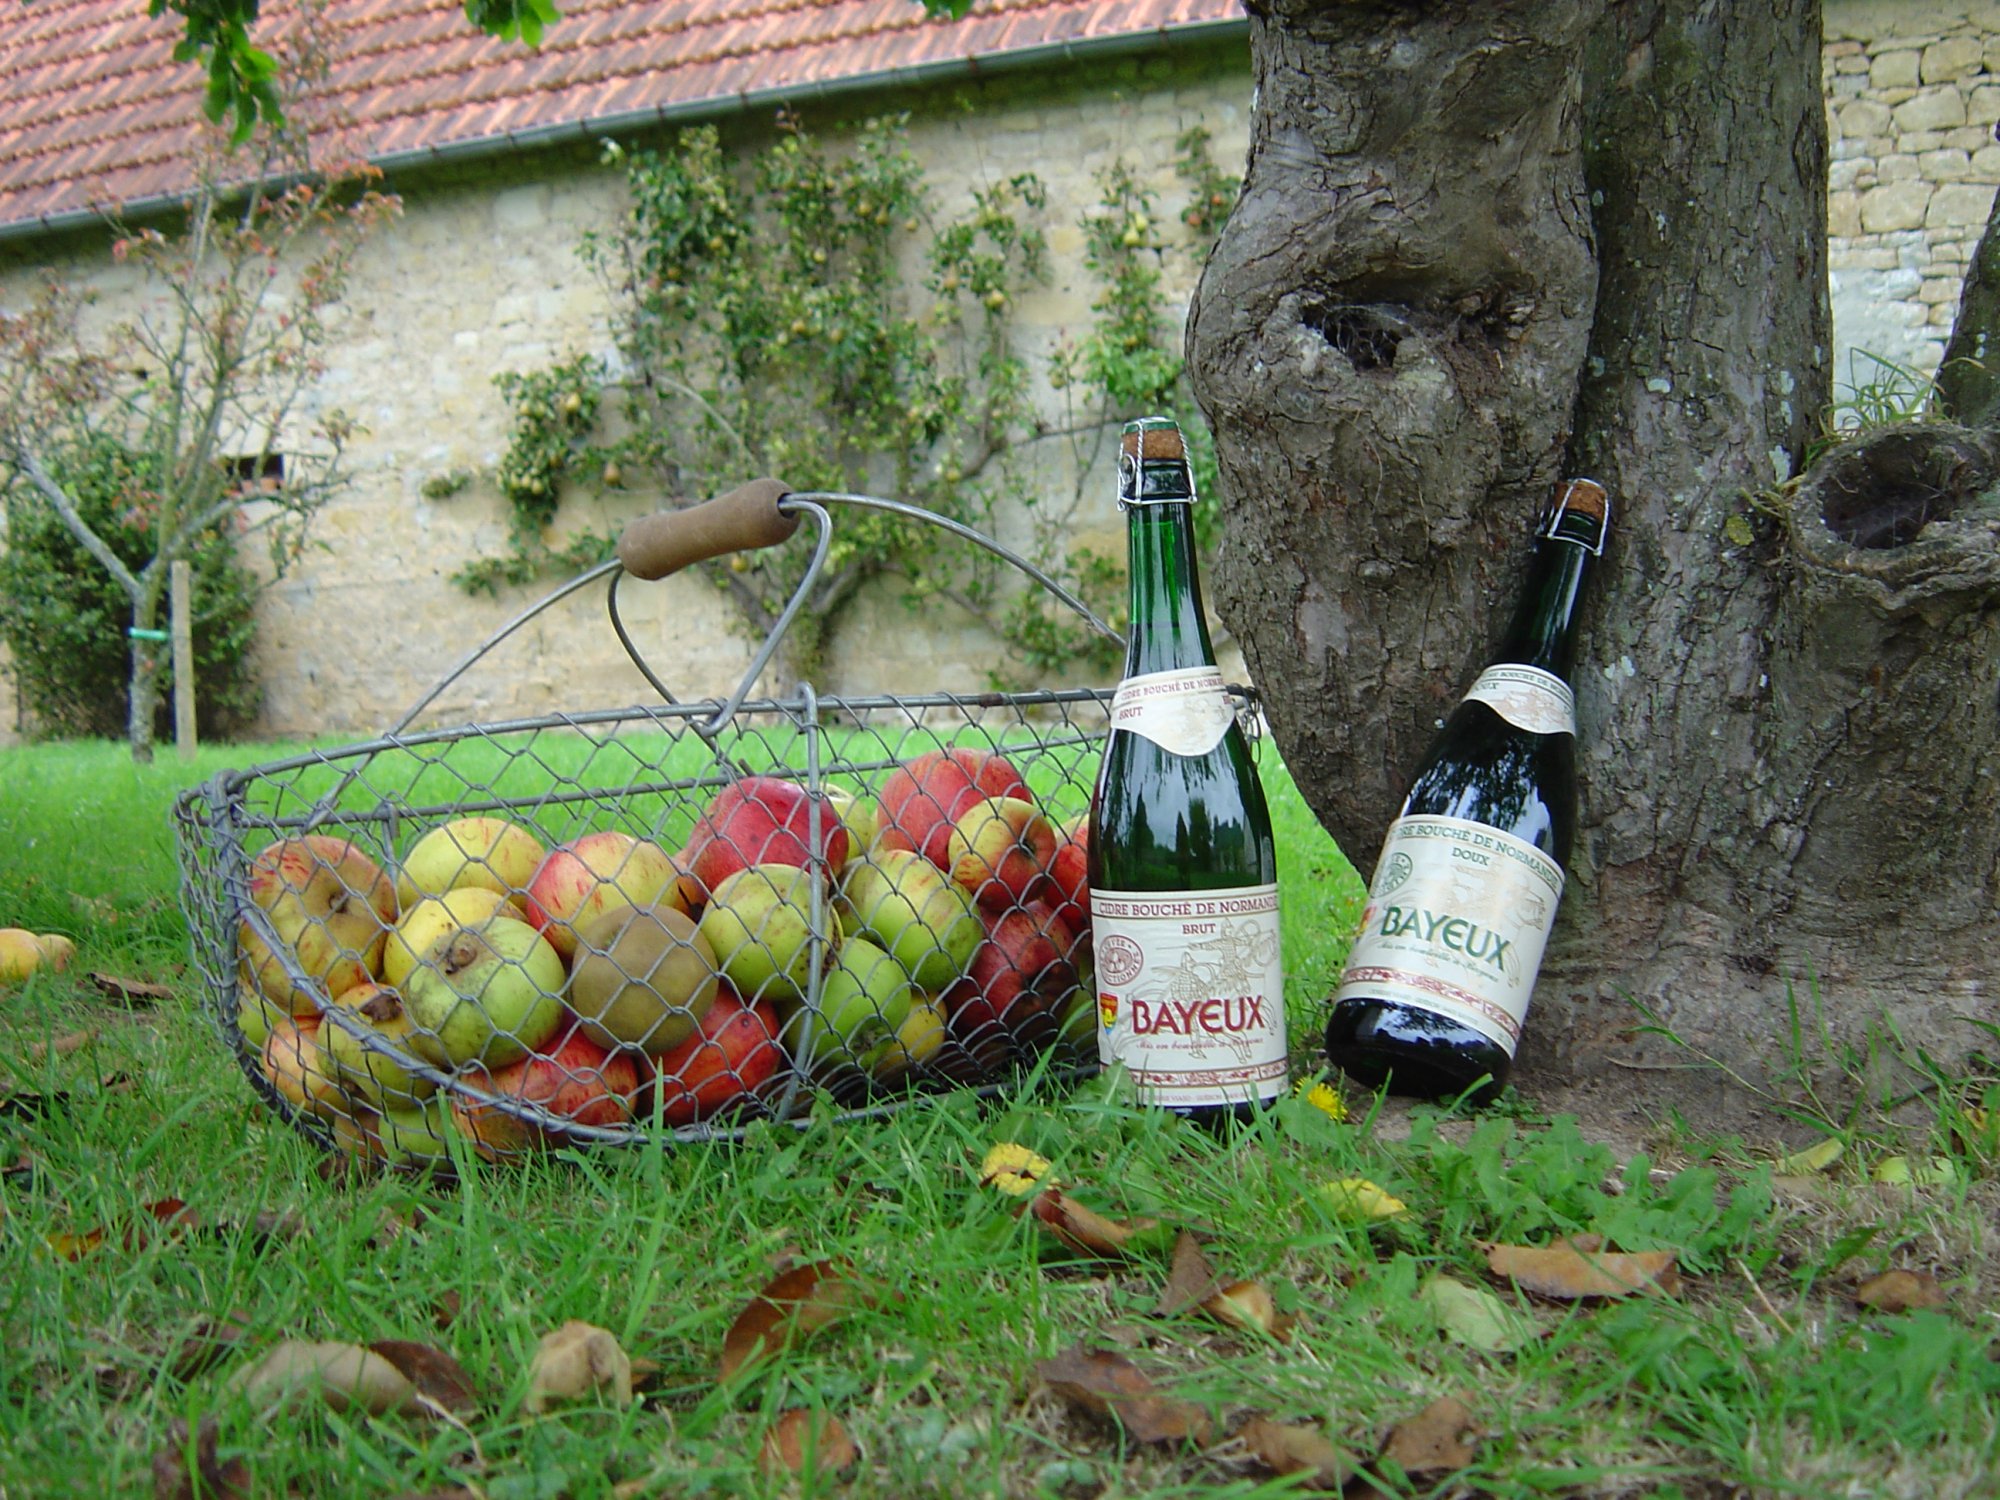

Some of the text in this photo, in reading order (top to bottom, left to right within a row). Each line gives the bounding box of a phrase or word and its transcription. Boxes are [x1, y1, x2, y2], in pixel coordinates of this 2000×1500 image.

[1120, 688, 1142, 701] CIDRE
[1143, 682, 1182, 696] BOUCHÉ
[1183, 680, 1196, 691] DE
[1118, 706, 1144, 721] BRUT
[1416, 824, 1469, 842] BOUCHÉ
[1474, 834, 1492, 848] DE
[1495, 841, 1558, 889] NORMANDIE
[1452, 847, 1490, 866] DOUX
[1098, 902, 1129, 916] CIDRE
[1131, 900, 1192, 917] BOUCHÉ
[1195, 902, 1216, 915] DE
[1181, 922, 1217, 936] BRUT
[1380, 907, 1511, 971] BAYEUX
[1131, 995, 1266, 1035] BAYEUX
